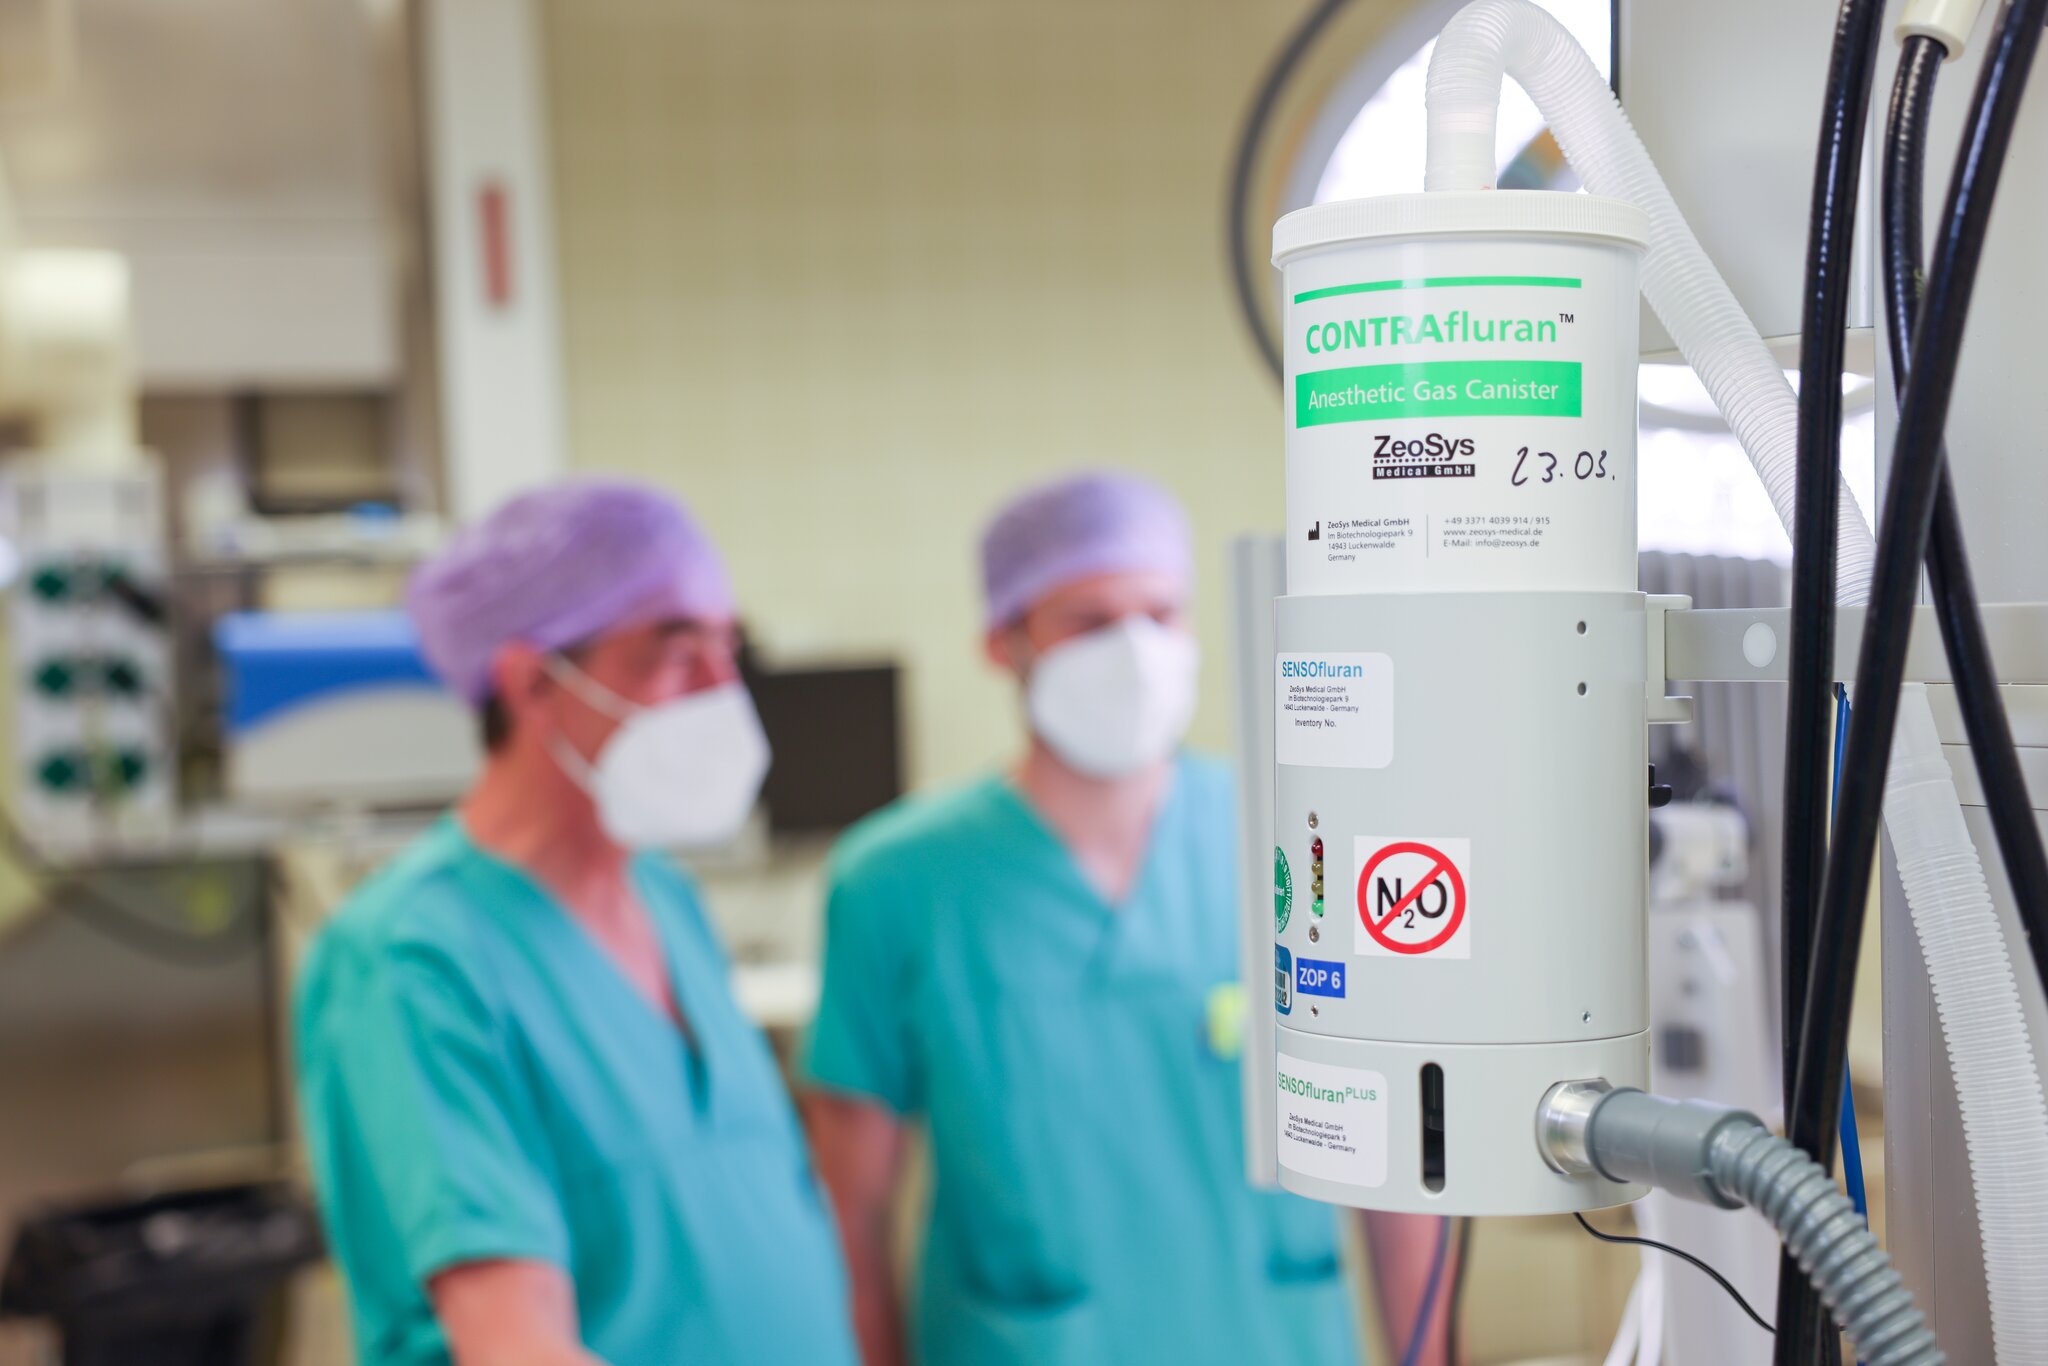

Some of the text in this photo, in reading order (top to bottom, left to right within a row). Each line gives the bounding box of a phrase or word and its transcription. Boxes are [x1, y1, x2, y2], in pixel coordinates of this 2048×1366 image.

[1308, 379, 1559, 411] Anesthetic Gas Canister
[1373, 433, 1475, 461] ZeoSys
[1375, 463, 1472, 478] Medical GmbH
[1327, 518, 1410, 530] ZeoSys Medical GmbH
[1444, 516, 1462, 525] +49
[1465, 516, 1486, 525] 3371
[1488, 516, 1511, 525] 4039
[1513, 516, 1529, 525] 914
[1535, 516, 1551, 525] 915
[1327, 529, 1414, 540] Im Biotechnologiepark 9
[1443, 528, 1543, 537] www.zeosys-medical.de
[1328, 541, 1396, 551] 14943 Luckenwalde
[1443, 539, 1540, 548] E-Mail: info@zeosys.de
[1327, 553, 1356, 562] Germany
[1282, 661, 1362, 678] SENSOfluran
[1305, 685, 1326, 693] Medical
[1330, 705, 1359, 713] Germany
[1294, 718, 1337, 729] Inventory No.
[1299, 967, 1341, 990] ZOP 6
[1304, 1117, 1323, 1128] Medical
[1324, 1122, 1344, 1132] GmbH
[1328, 1141, 1357, 1155] Germany
